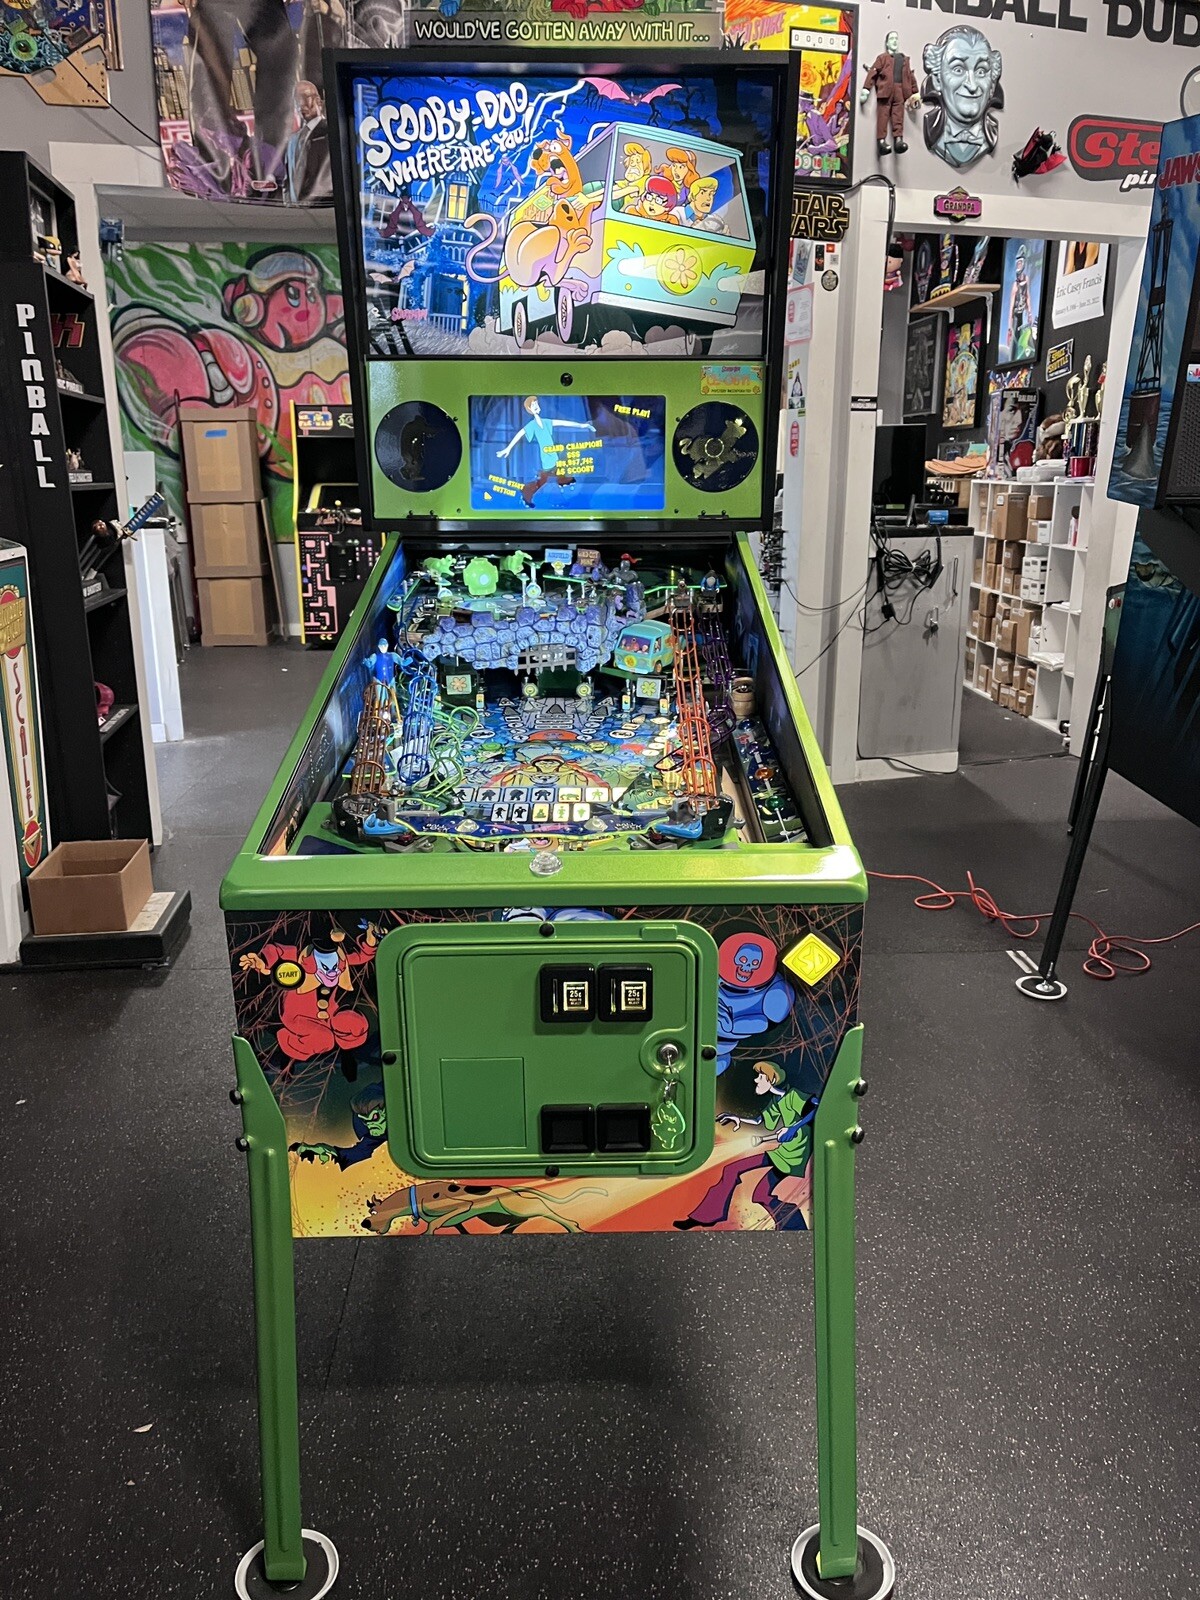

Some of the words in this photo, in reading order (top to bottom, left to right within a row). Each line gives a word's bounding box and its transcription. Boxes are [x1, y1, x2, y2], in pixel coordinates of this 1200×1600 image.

[415, 20, 501, 41] WOULD'VE
[505, 20, 574, 42] GOTTEN
[578, 21, 627, 42] AWAY
[630, 22, 674, 42] WITH
[676, 22, 710, 42] IT...
[374, 148, 456, 193] WHERE
[459, 143, 496, 172] ARE
[793, 194, 848, 219] TAR
[943, 200, 975, 212] GRANDPA
[791, 214, 847, 240] ARS
[1066, 282, 1082, 295] Casey
[1082, 273, 1103, 290] Francis
[15, 303, 56, 488] PINBALL
[613, 404, 631, 415] FREE
[632, 406, 651, 418] PLAY!
[543, 443, 565, 454] GRAND
[566, 439, 603, 450] CHAMPION!
[567, 465, 595, 475] SCOOBY
[488, 474, 507, 485] PRESS
[507, 480, 526, 491] START
[278, 970, 299, 979] START
